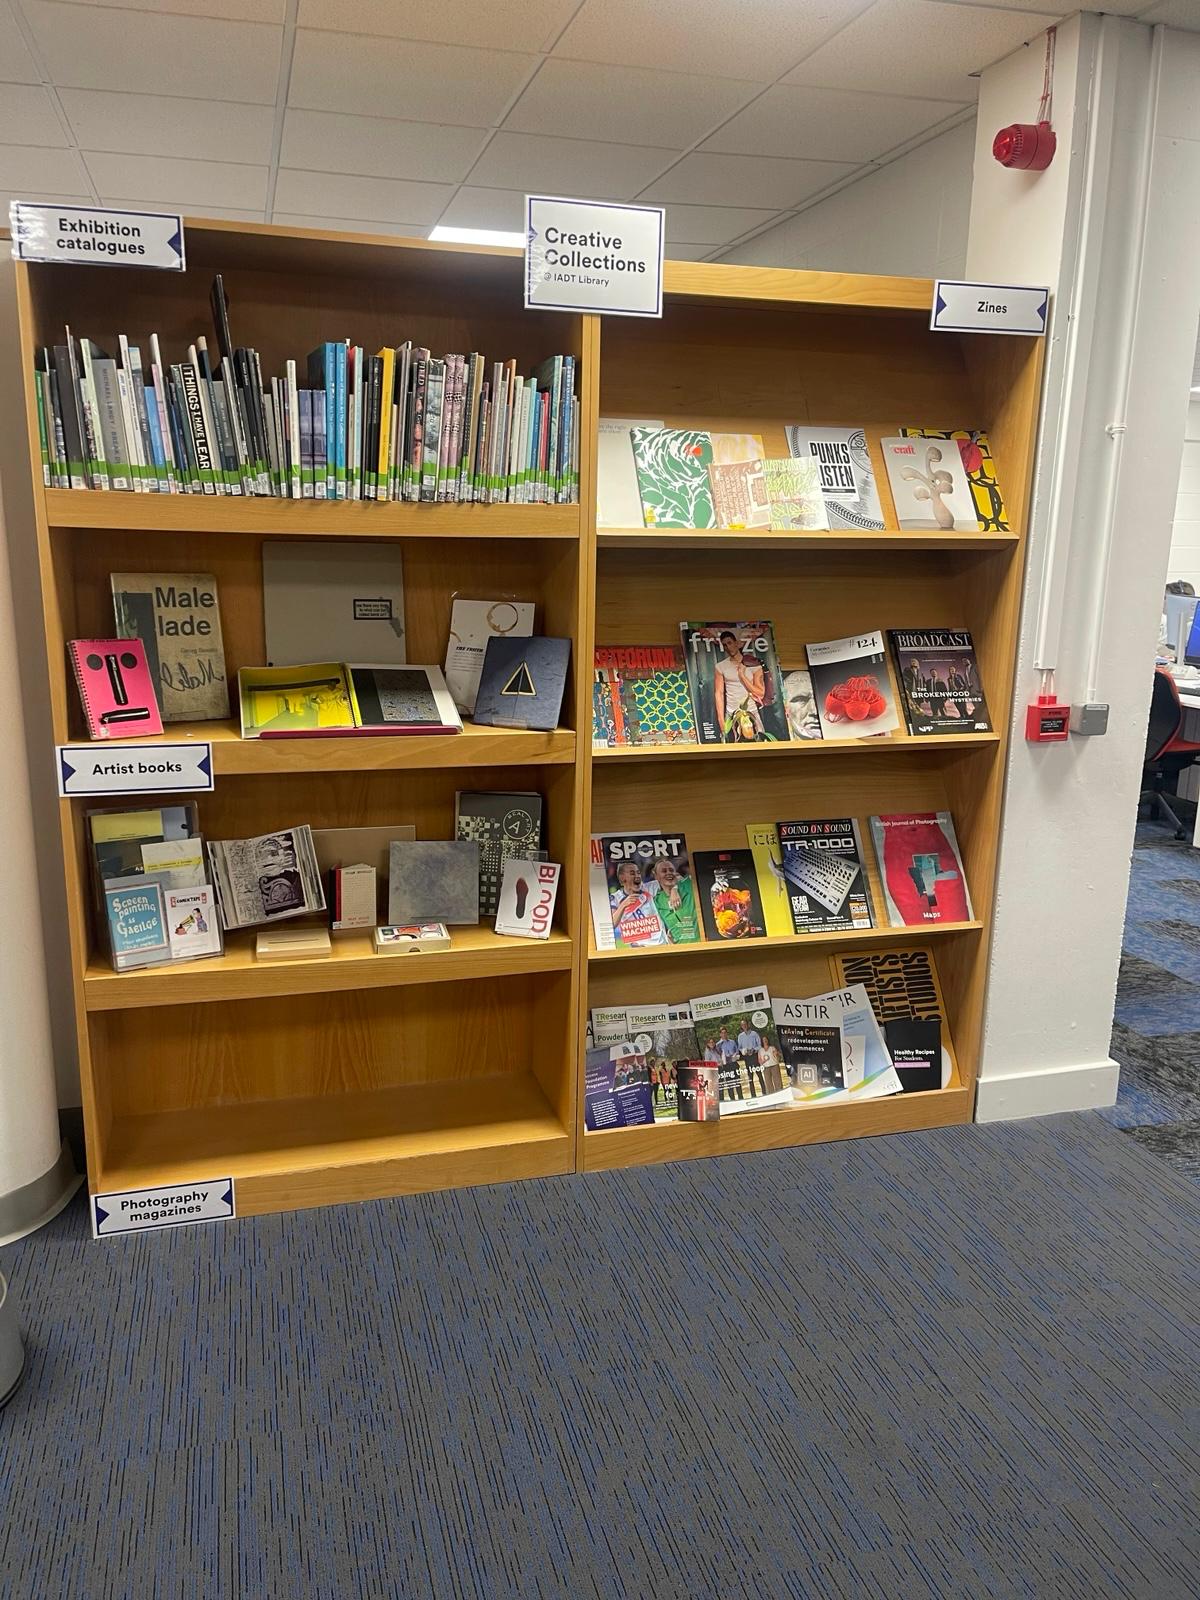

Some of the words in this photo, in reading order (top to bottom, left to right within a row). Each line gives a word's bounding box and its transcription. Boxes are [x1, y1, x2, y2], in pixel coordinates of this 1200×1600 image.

[58, 217, 141, 238] Exhibition
[56, 237, 146, 256] catalogues
[544, 227, 623, 250] Creative
[544, 249, 646, 273] Collections
[553, 273, 576, 284] IADT
[578, 275, 610, 288] Library
[977, 301, 1008, 314] Zines
[183, 370, 200, 411] THINGS
[194, 416, 205, 439] HAVE
[196, 439, 210, 469] LEAR
[810, 442, 851, 464] PUNKS
[893, 444, 915, 455] craft
[820, 465, 855, 487] ISTEN
[155, 587, 215, 608] Male
[158, 615, 211, 636] lade
[688, 632, 769, 653] frize
[897, 634, 970, 647] BROADCAST
[911, 691, 970, 699] BROKENWOOD
[92, 764, 134, 776] Artist
[138, 761, 182, 774] books
[781, 824, 809, 836] SOUND
[810, 824, 823, 833] ON
[824, 823, 851, 833] SOUND
[609, 838, 681, 860] SPORT
[782, 838, 854, 851] TR-1000
[923, 911, 941, 919] Maps
[620, 917, 658, 931] WINNING
[622, 924, 659, 938] MACHINE
[694, 999, 732, 1011] TResearch
[783, 1003, 830, 1019] ASTIR
[595, 1012, 626, 1020] TResear
[630, 1013, 667, 1023] TResearch
[736, 1065, 748, 1076] the
[749, 1064, 765, 1074] loop
[120, 1191, 209, 1211] Photography
[129, 1204, 202, 1222] magazines
